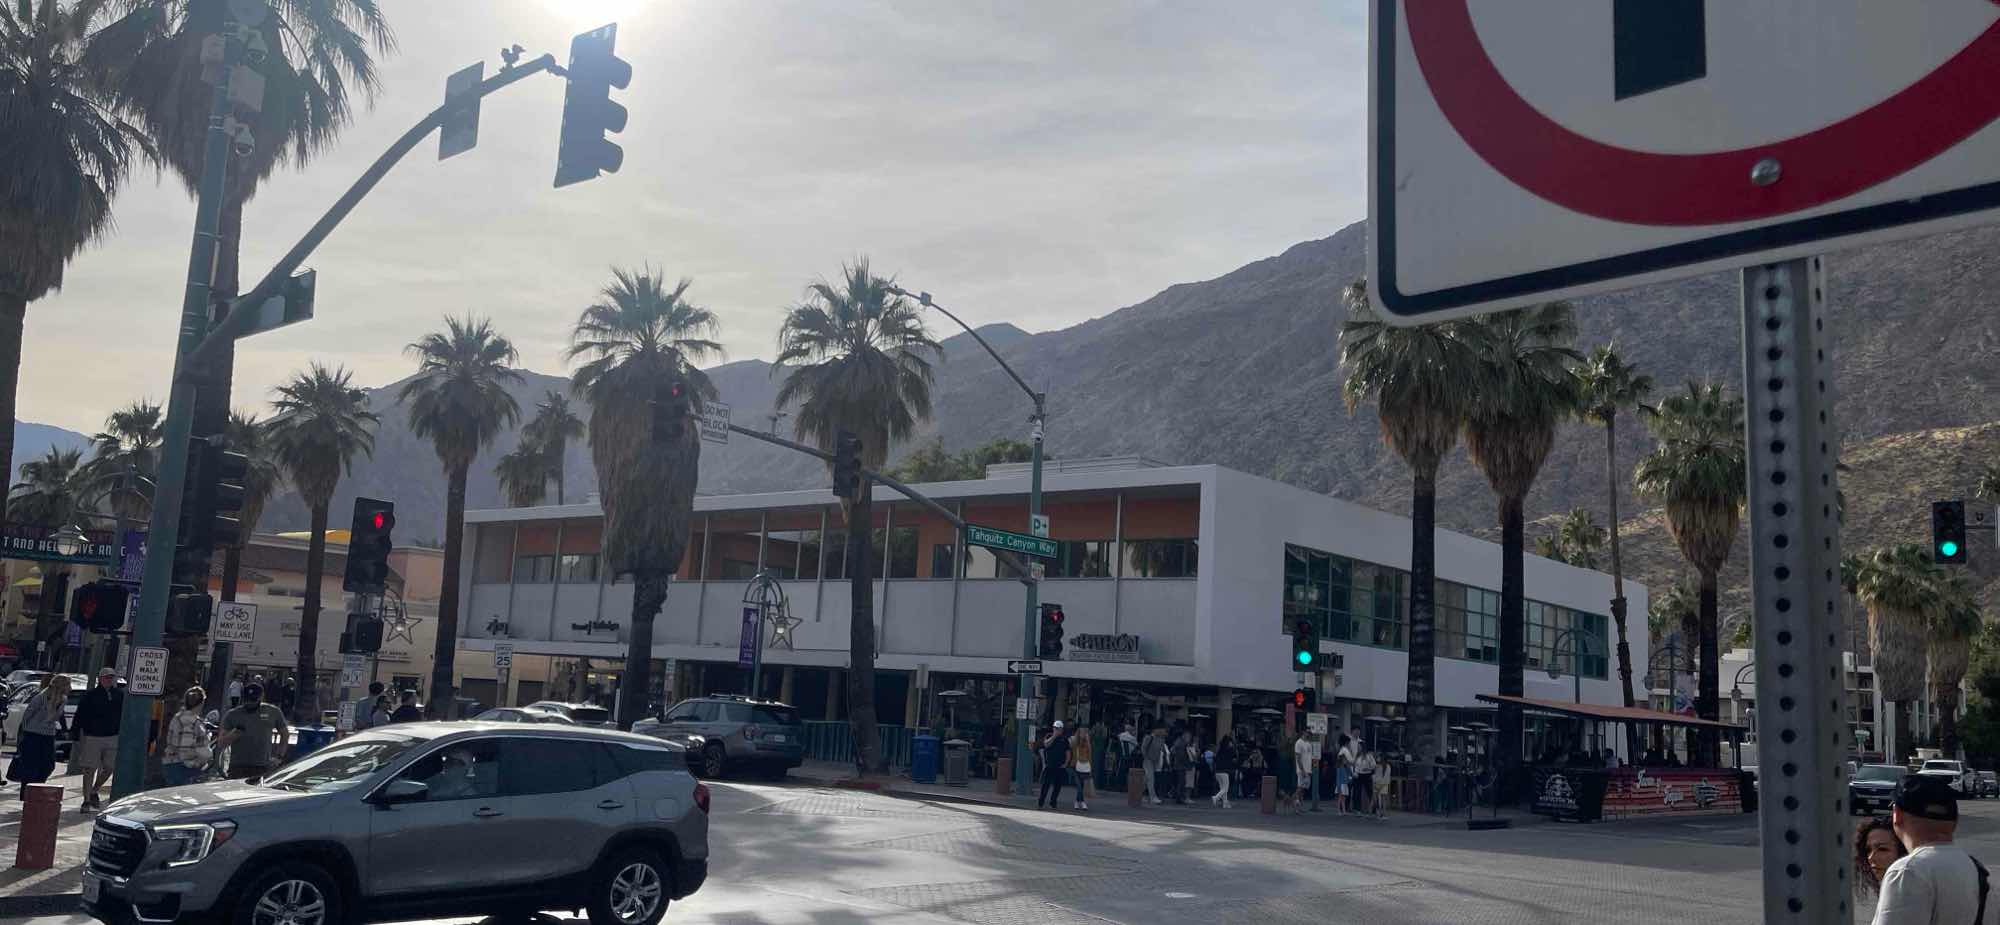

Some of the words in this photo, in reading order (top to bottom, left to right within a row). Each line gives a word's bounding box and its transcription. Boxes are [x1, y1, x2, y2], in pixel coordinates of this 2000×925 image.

[705, 404, 715, 416] DO
[716, 408, 728, 418] NOT
[12, 538, 34, 550] AND
[969, 528, 1004, 545] Tahquitz
[1007, 536, 1036, 550] Canyon
[1039, 543, 1056, 553] Way
[220, 622, 233, 630] MAY
[237, 623, 250, 631] USE
[216, 630, 233, 638] FULL
[234, 630, 254, 640] LANE
[139, 650, 163, 659] CROSS
[496, 656, 511, 666] 25
[139, 666, 159, 674] WALK
[135, 674, 159, 682] SIGNAL
